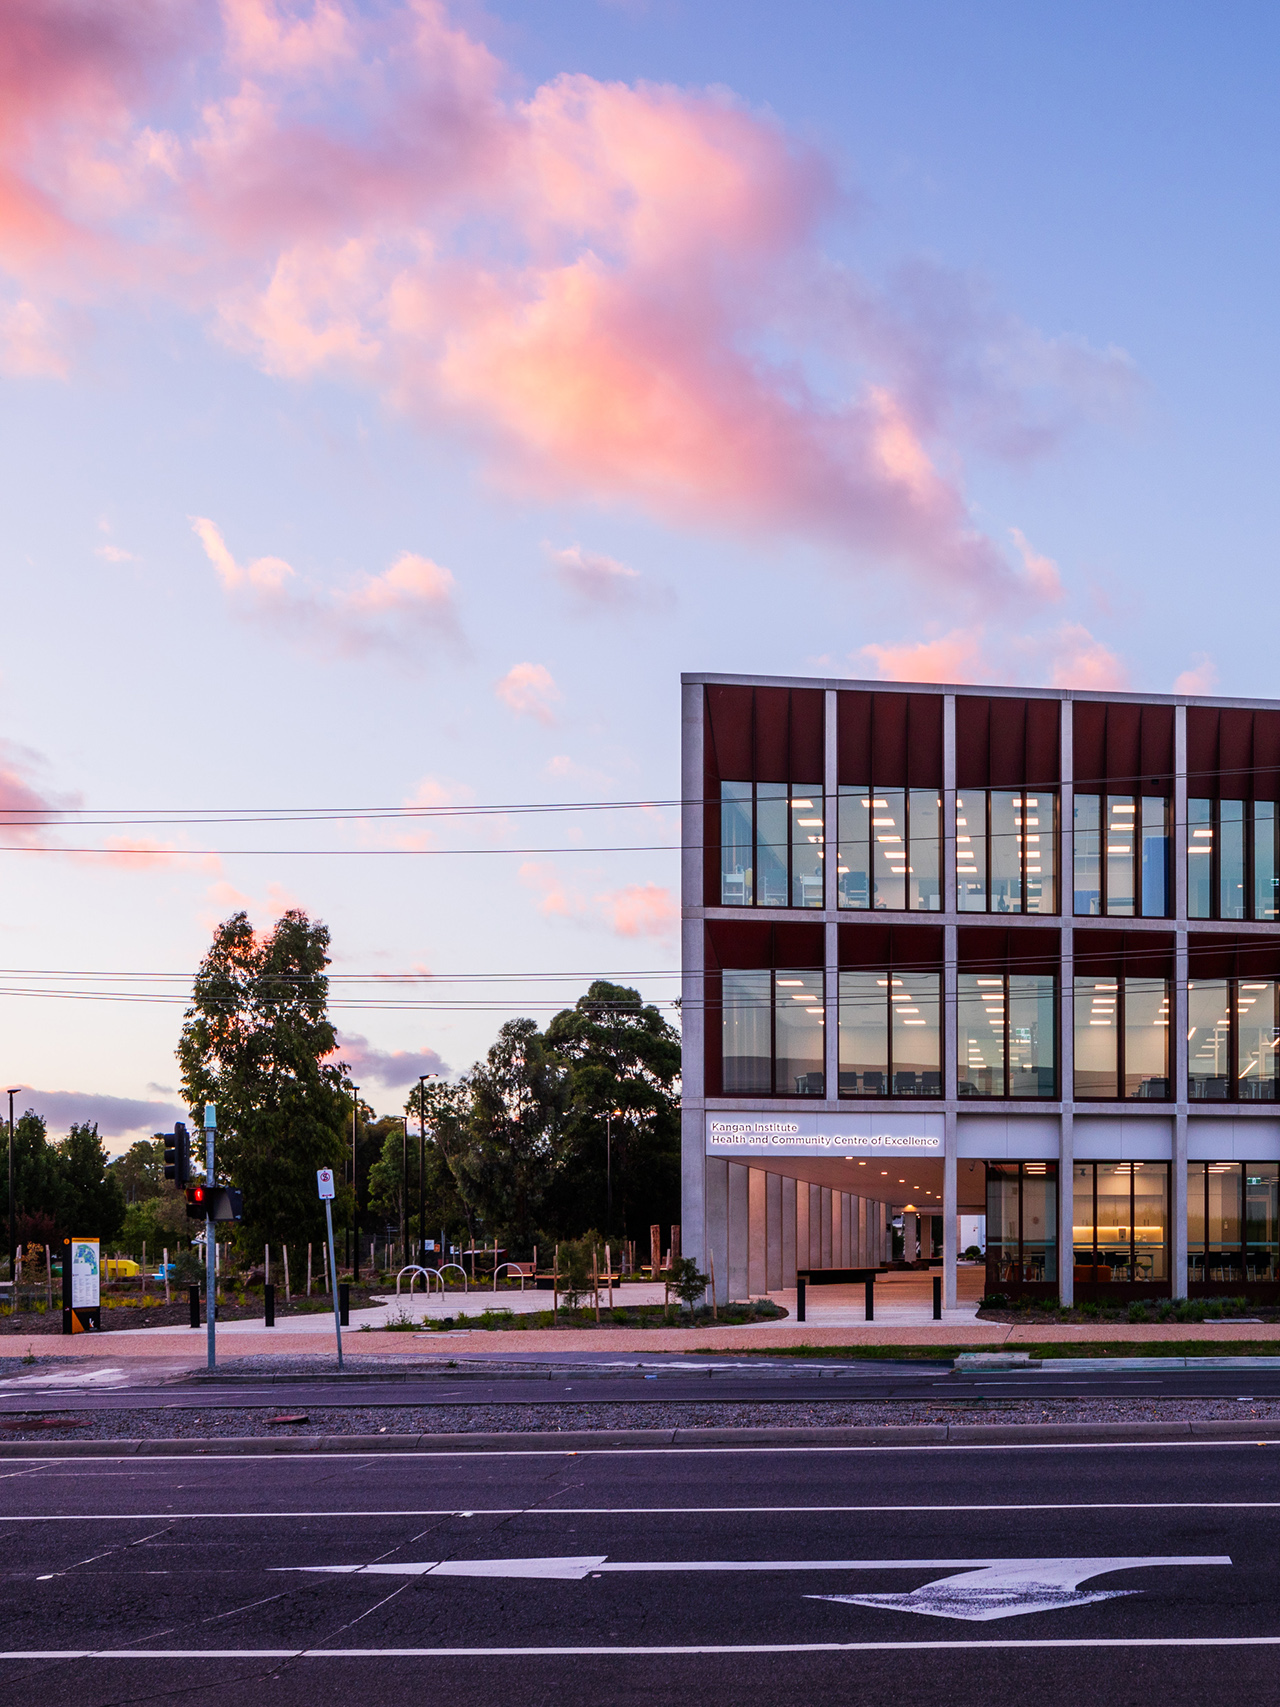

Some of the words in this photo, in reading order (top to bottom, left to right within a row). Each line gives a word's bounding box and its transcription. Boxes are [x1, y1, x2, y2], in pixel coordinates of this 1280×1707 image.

[712, 1122, 752, 1133] Kangan
[754, 1123, 798, 1132] Institute
[712, 1135, 746, 1144] Health
[749, 1135, 769, 1144] and
[771, 1135, 831, 1146] Community
[834, 1136, 868, 1145] Centre
[871, 1136, 882, 1145] of
[884, 1137, 939, 1146] Excellence
